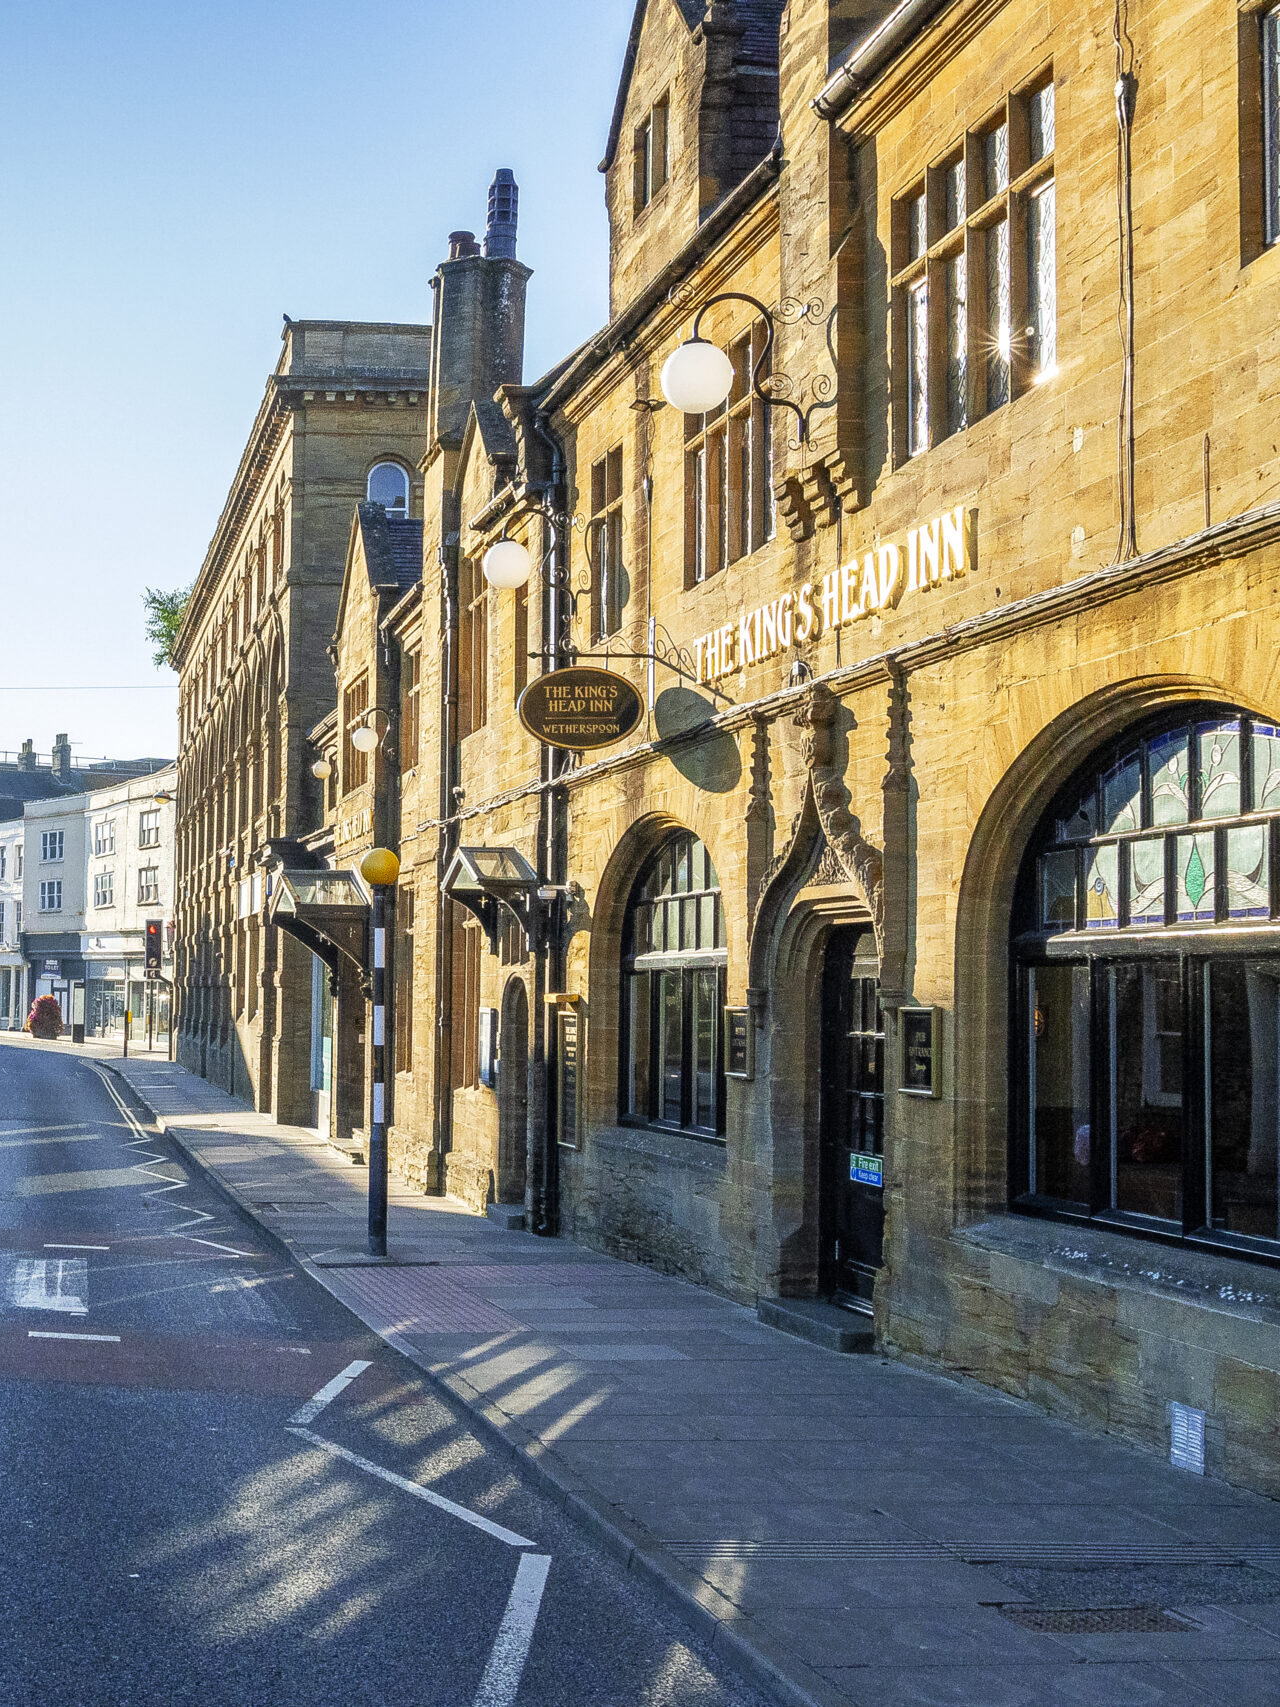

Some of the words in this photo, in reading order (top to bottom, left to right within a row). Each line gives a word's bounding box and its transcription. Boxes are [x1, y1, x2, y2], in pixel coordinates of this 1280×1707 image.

[693, 621, 734, 685] THE
[738, 584, 814, 667] KING'S
[821, 543, 898, 631] HEAD
[907, 506, 965, 592] INN
[544, 686, 571, 698] THE
[575, 685, 618, 698] KING'S
[549, 700, 586, 712] HEAD
[590, 700, 613, 712] INN
[542, 723, 620, 734] WETHERSPOON
[858, 1157, 868, 1169] Fire
[869, 1161, 879, 1172] exit
